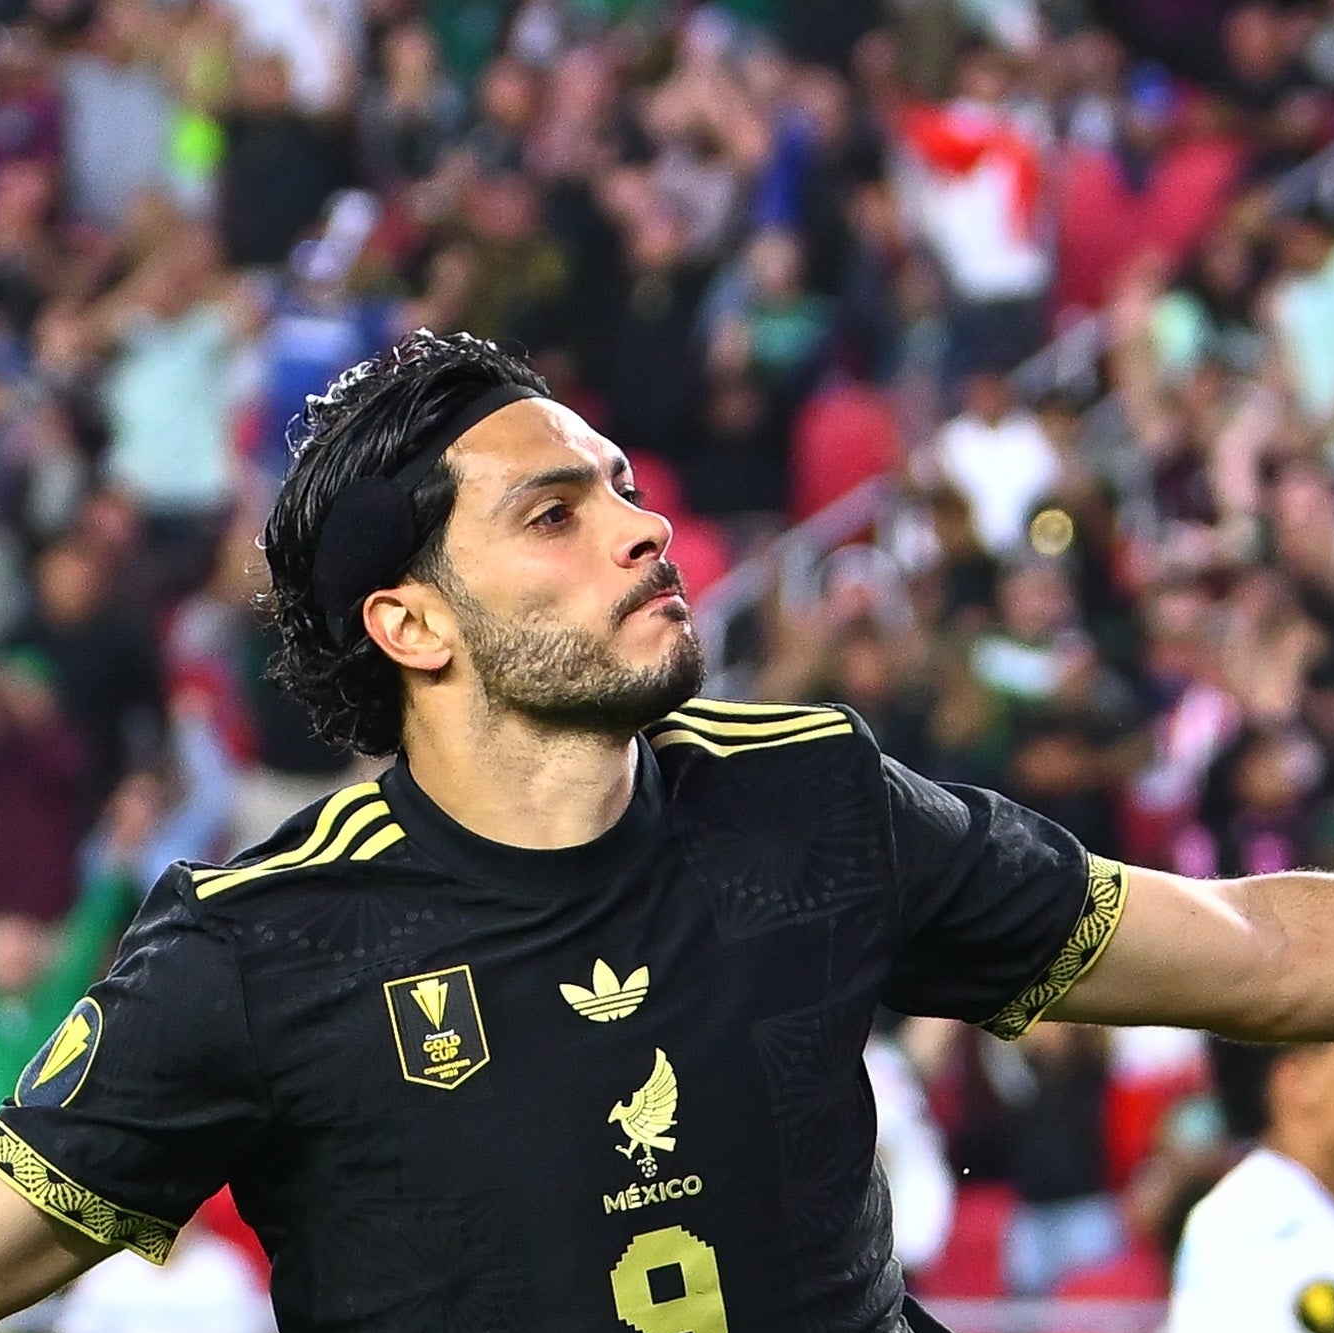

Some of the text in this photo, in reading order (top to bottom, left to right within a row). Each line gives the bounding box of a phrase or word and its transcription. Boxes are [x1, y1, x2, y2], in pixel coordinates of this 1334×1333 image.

[423, 1035, 461, 1052] GOLD
[430, 1046, 458, 1062] CUP
[603, 1175, 702, 1214] MÉXICO
